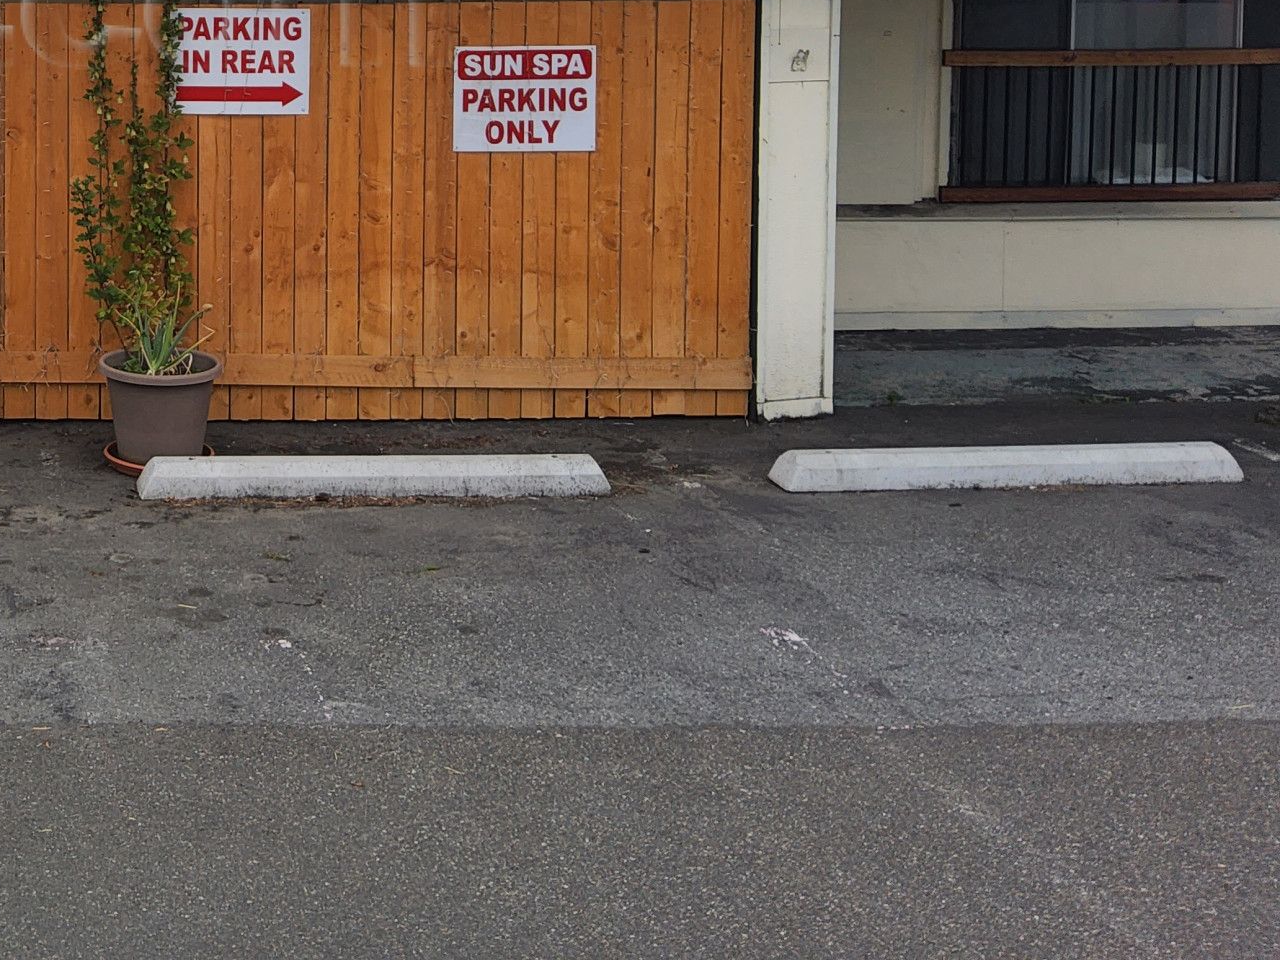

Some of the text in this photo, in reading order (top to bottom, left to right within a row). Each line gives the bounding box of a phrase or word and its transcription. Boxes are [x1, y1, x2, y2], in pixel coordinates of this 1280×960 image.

[178, 16, 303, 41] PARKING
[183, 49, 296, 74] IN REAR
[463, 53, 587, 76] SUN SPA
[462, 87, 589, 113] PARKING
[485, 119, 561, 145] ONLY
